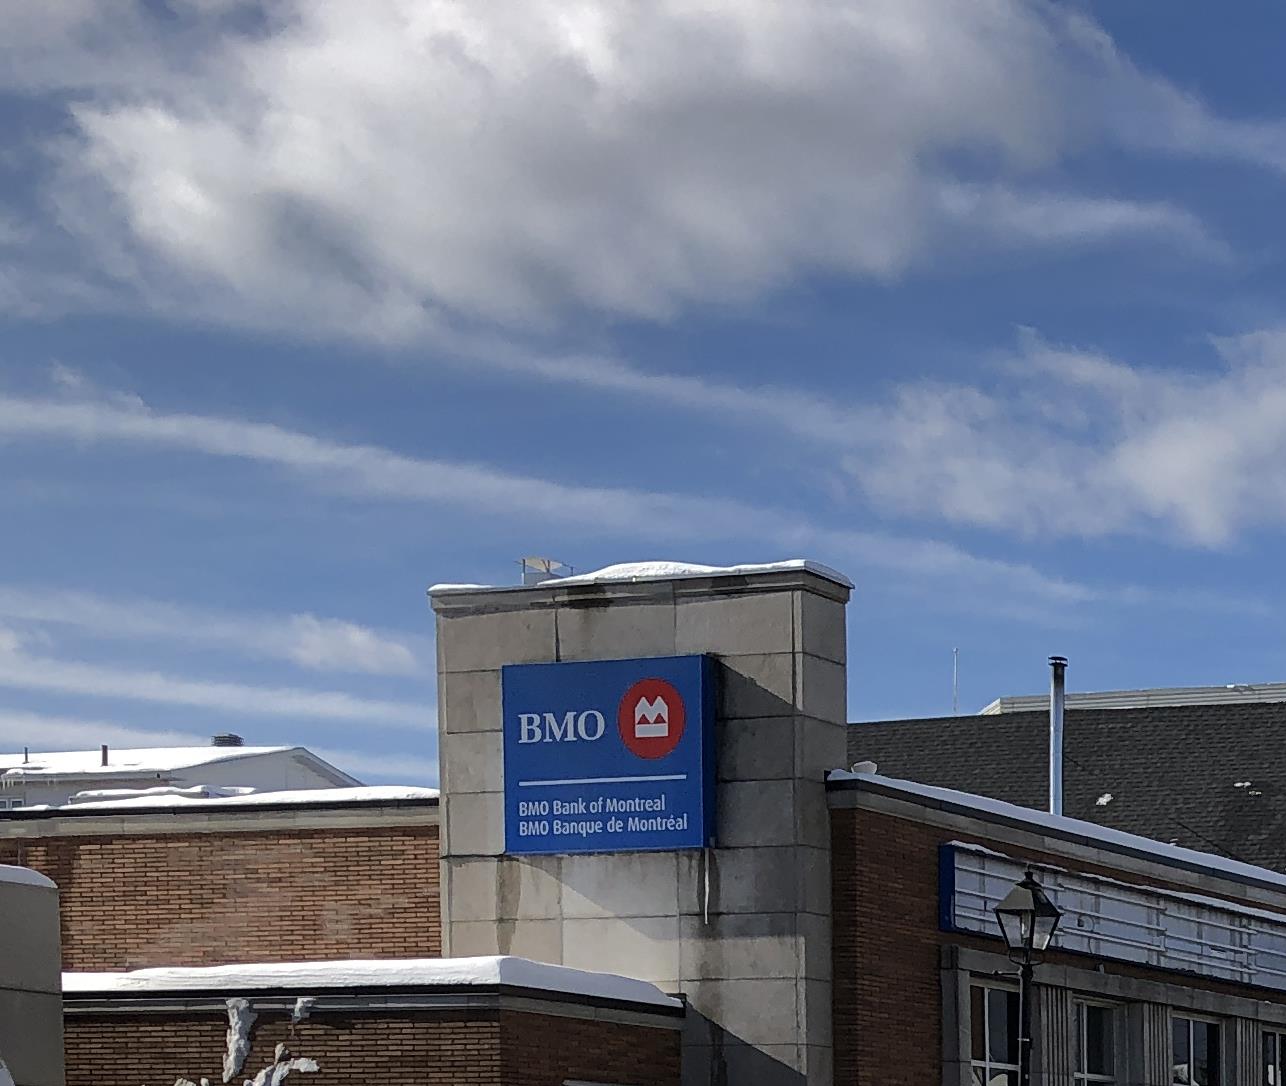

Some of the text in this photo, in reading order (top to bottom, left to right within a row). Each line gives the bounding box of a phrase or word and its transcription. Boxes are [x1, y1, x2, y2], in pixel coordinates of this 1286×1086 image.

[518, 710, 605, 743] BMO
[519, 794, 665, 816] BMO Bank of Montreal
[519, 813, 688, 837] BMO Banque de Montréal
